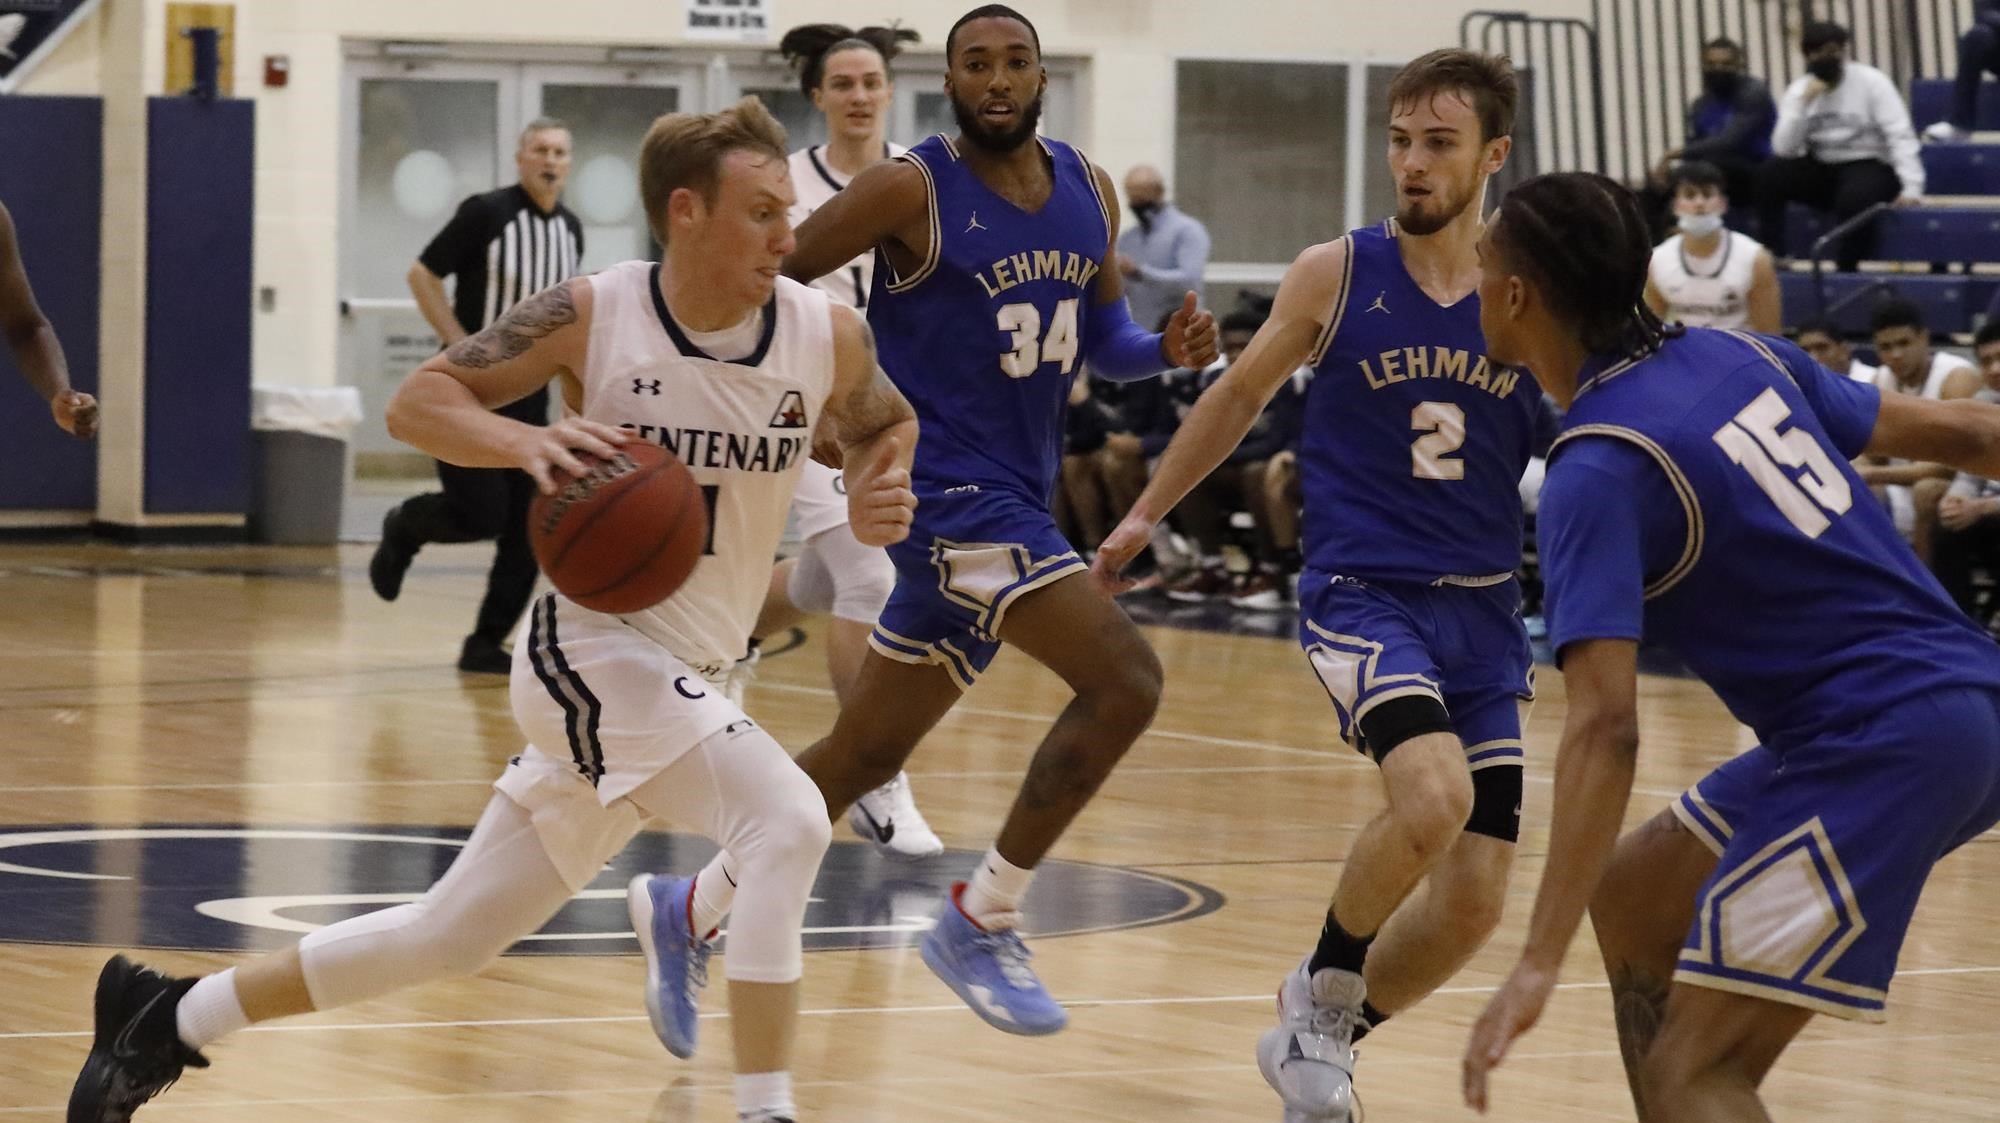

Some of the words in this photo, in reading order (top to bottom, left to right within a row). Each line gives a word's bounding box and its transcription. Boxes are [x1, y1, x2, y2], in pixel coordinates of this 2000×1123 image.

[975, 251, 1099, 298] LEHMAN
[996, 298, 1079, 378] 34
[1358, 346, 1520, 399] LEHMAN
[619, 424, 807, 472] NTENARY
[1411, 401, 1465, 480] 2
[1712, 386, 1852, 539] 15
[674, 677, 705, 699] C
